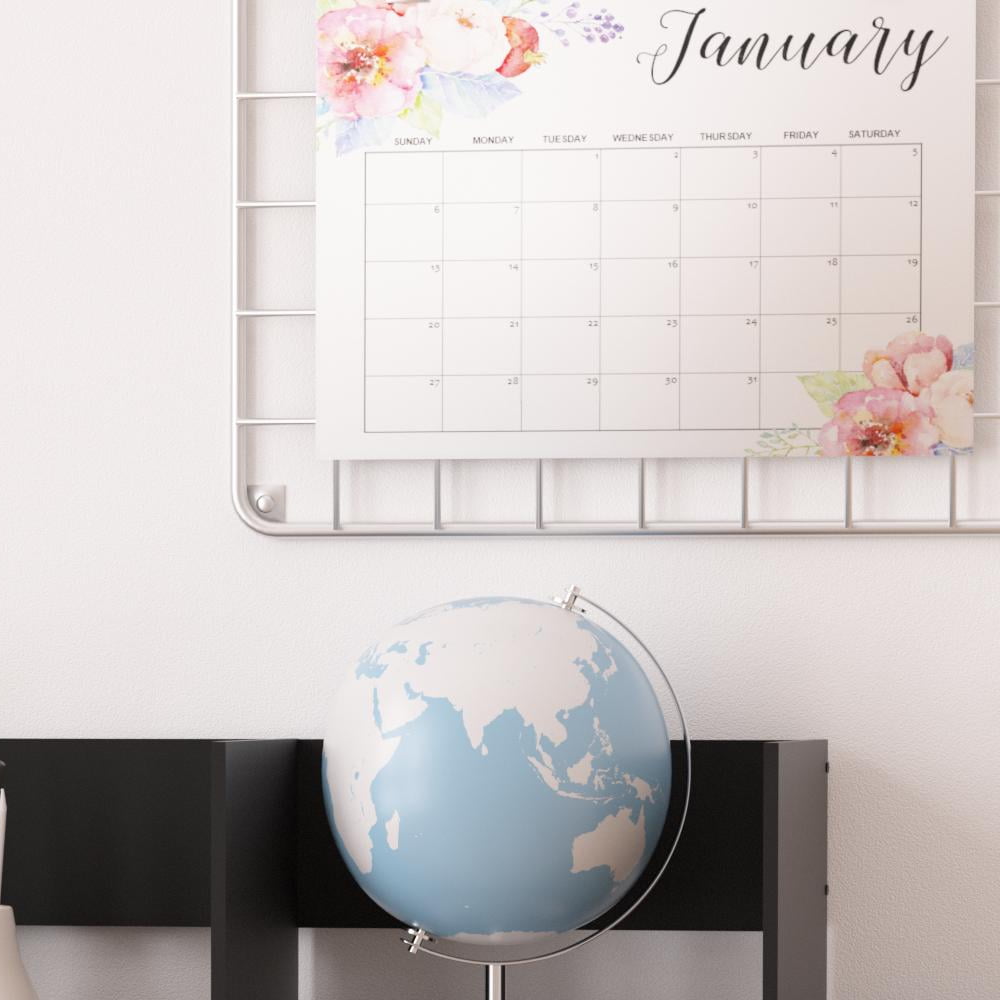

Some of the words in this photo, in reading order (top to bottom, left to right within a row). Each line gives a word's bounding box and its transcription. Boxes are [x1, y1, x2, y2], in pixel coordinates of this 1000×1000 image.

[637, 8, 949, 91] January
[394, 137, 432, 146] SUNDAY
[473, 136, 514, 144] MONDAY
[543, 134, 588, 143] TUESDAY
[613, 133, 674, 142] WEDNESDAY
[700, 131, 752, 141] THURSDAY
[784, 130, 819, 140] FRIDAY
[848, 129, 901, 139] SATURDAY
